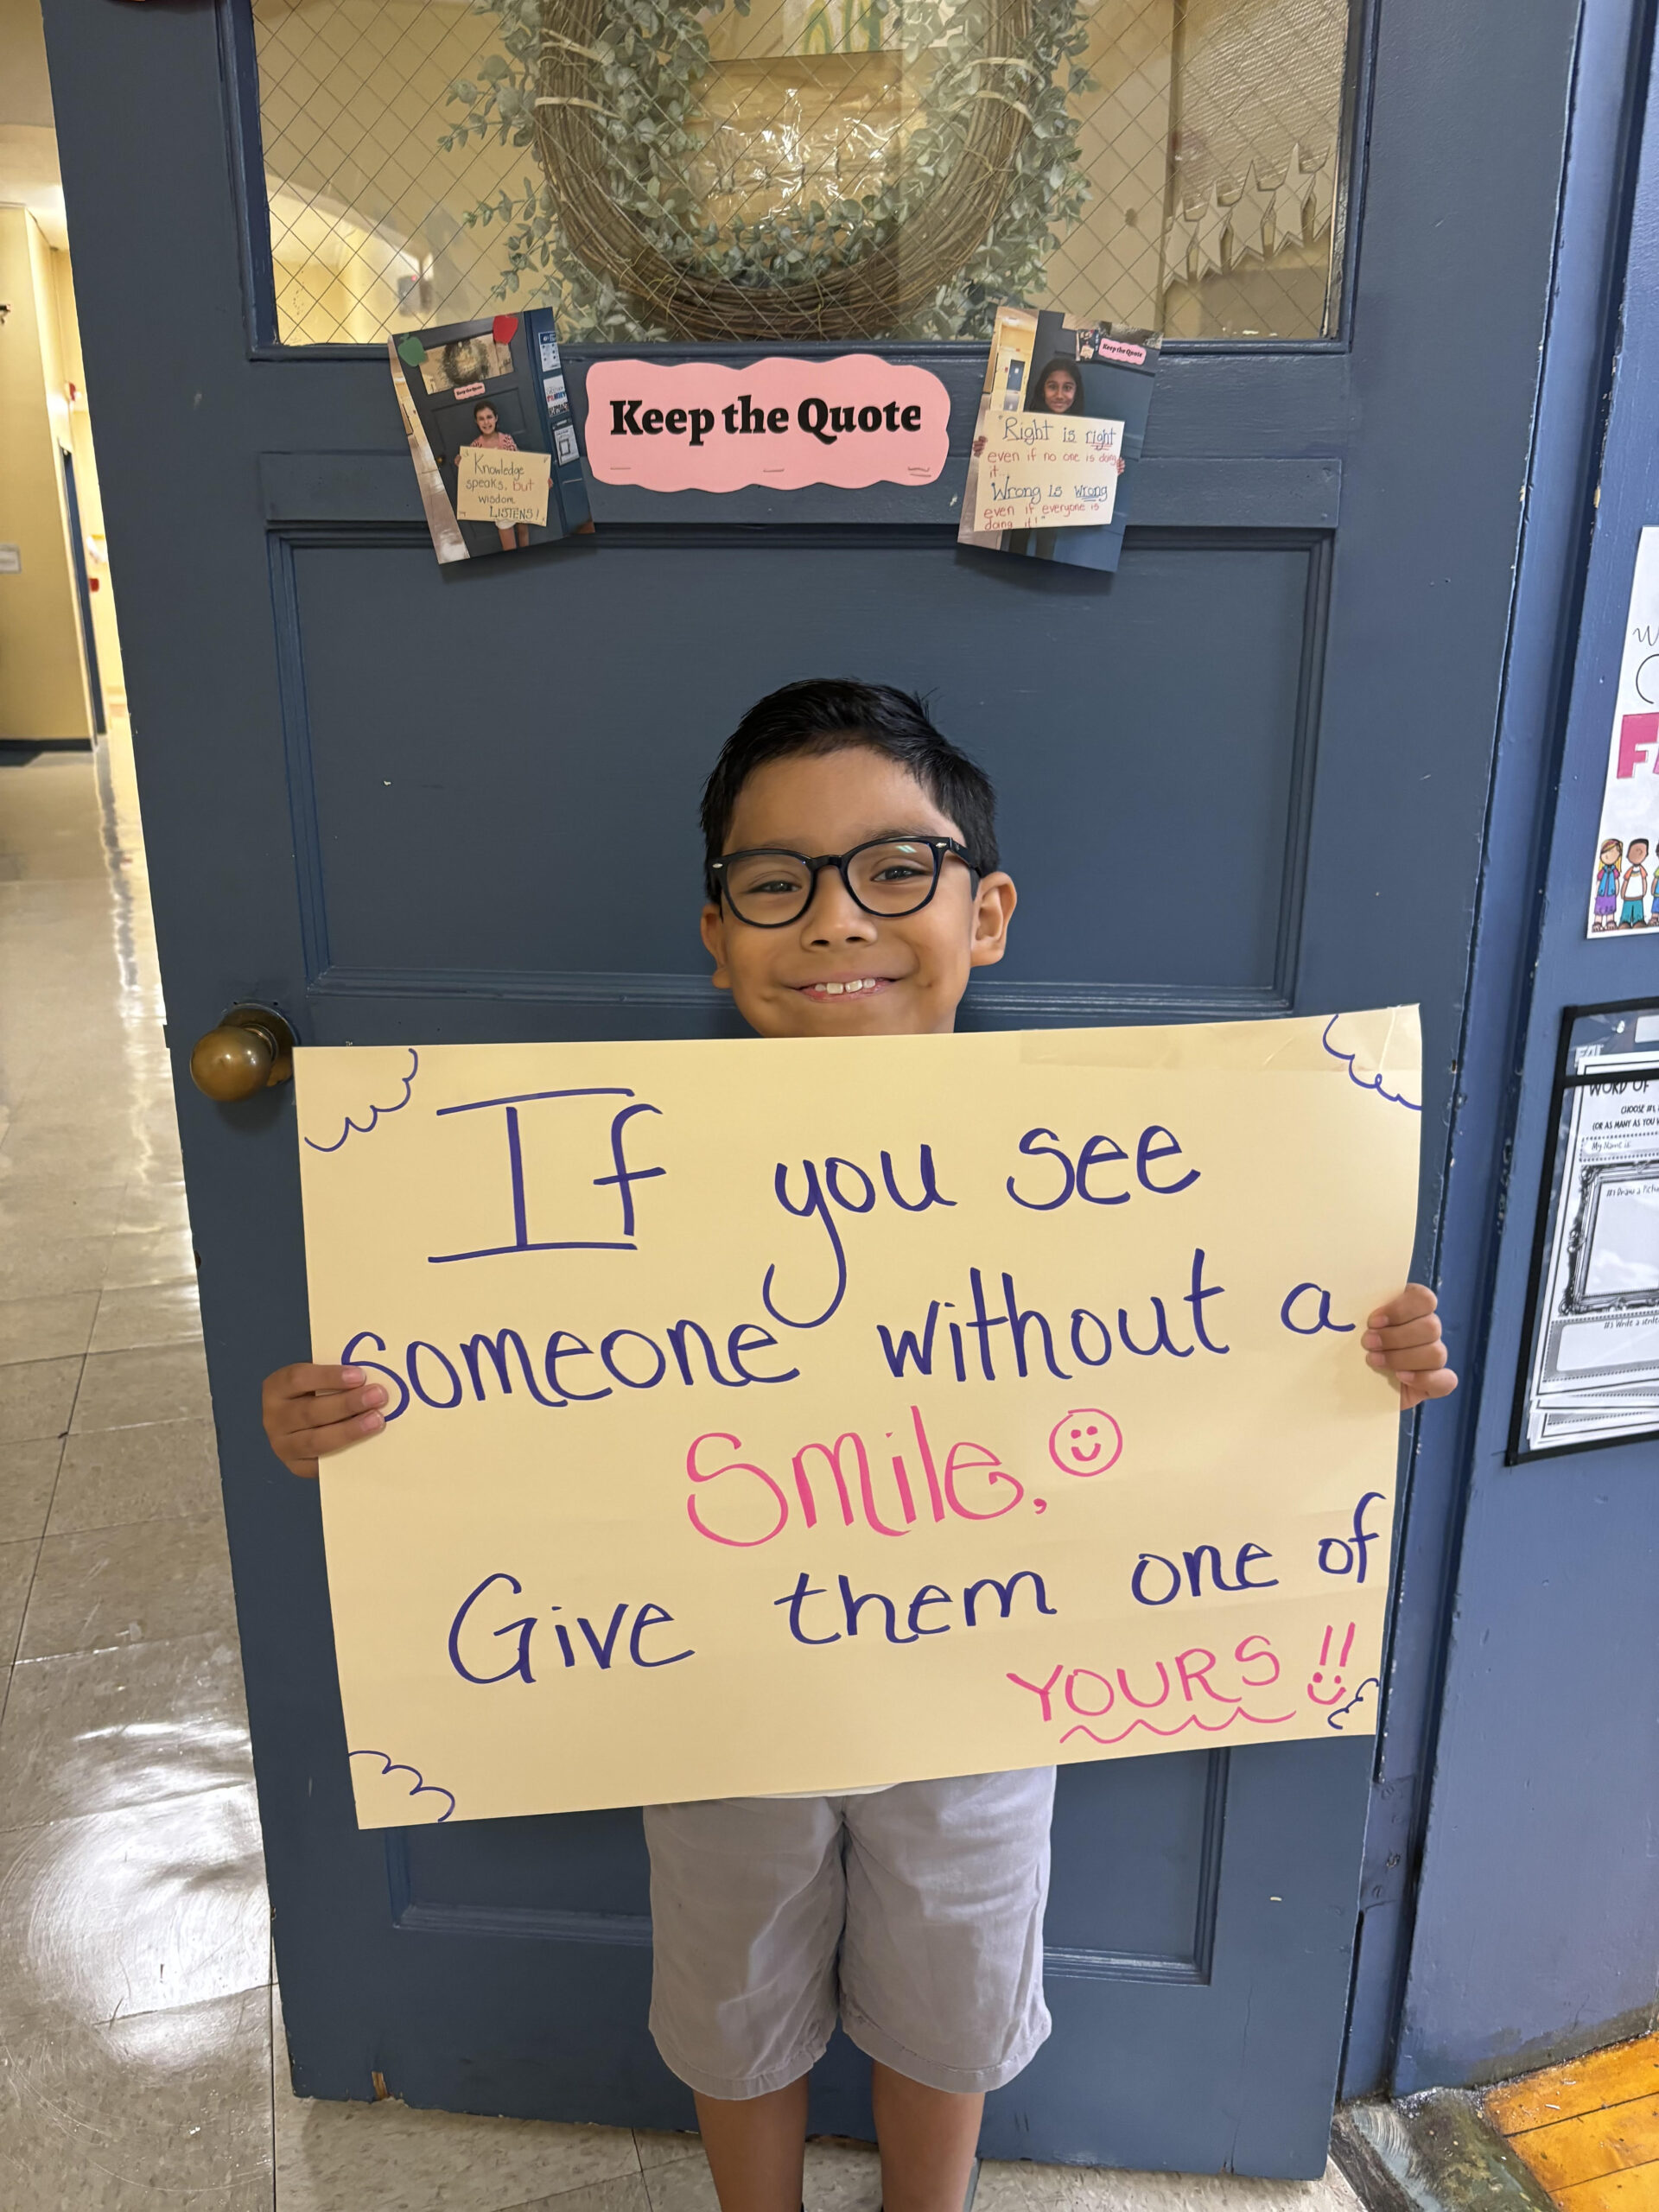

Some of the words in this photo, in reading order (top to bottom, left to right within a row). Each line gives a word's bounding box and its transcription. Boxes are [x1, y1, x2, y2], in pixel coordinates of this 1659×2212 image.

[610, 399, 715, 446] Keep
[721, 394, 788, 435] the
[798, 397, 922, 445] Quote
[1063, 427, 1077, 442] is
[1085, 427, 1117, 450] right
[988, 451, 1020, 463] even
[1027, 448, 1037, 461] if
[1044, 453, 1057, 461] no
[1063, 453, 1079, 462] one
[1086, 454, 1095, 462] is
[474, 452, 524, 481] Knowledge
[513, 479, 535, 491] but
[991, 475, 1041, 505] Wrong
[1048, 484, 1063, 498] is
[984, 507, 1014, 519] even
[1026, 504, 1035, 514] if
[1042, 503, 1086, 518] everyone
[985, 518, 1014, 531] doing
[1605, 1121, 1612, 1129] AS
[1614, 1119, 1631, 1128] MANY
[1632, 1118, 1641, 1127] AS
[1643, 1117, 1656, 1127] YOU
[1592, 1141, 1602, 1152] My
[1617, 1187, 1635, 1197] Draw
[428, 1088, 667, 1263] If
[762, 1143, 958, 1329] you
[1006, 1125, 1201, 1211] see
[876, 1248, 1230, 1382] without
[1281, 1282, 1356, 1334] a
[1616, 1318, 1633, 1327] Write
[448, 1573, 696, 1684] Give
[774, 1571, 1058, 1644] them
[1131, 1542, 1280, 1605] one
[1318, 1491, 1387, 1584] of
[1006, 1635, 1281, 1722] YOURS
